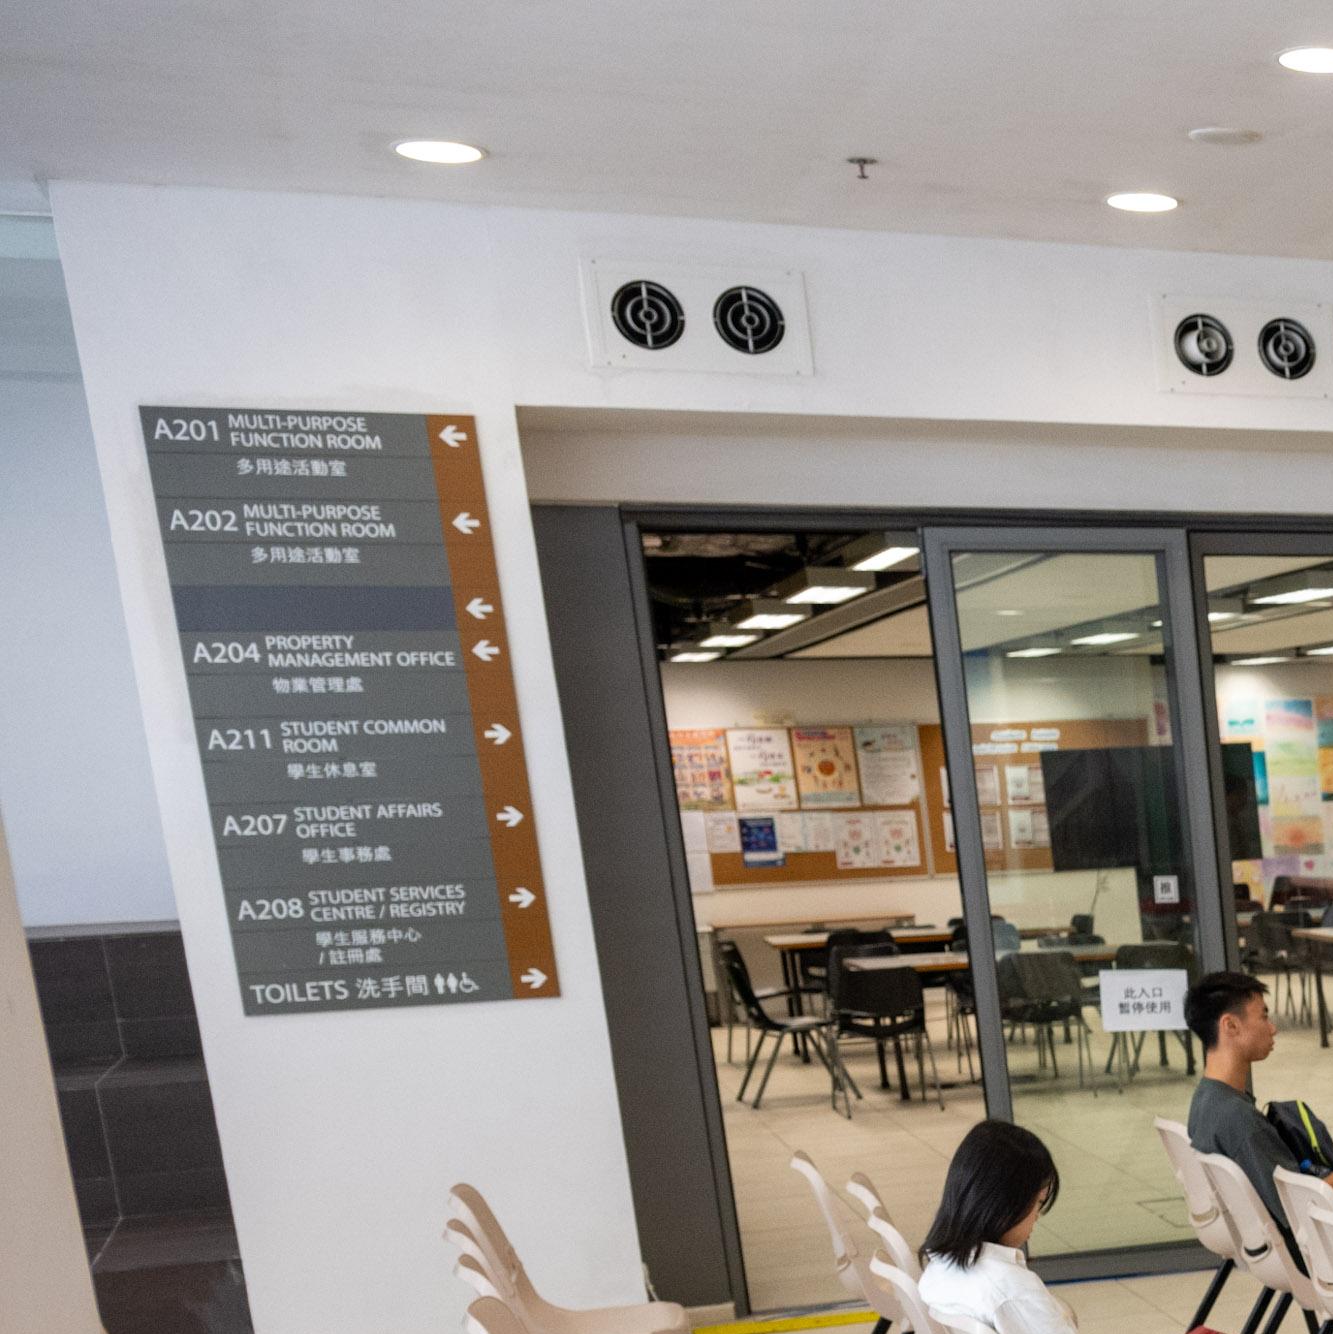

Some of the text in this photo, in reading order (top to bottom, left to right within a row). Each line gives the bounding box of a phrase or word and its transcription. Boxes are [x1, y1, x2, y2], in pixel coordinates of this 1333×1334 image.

[154, 418, 219, 442] A201
[228, 414, 367, 434] MULTI-PURPOSE
[231, 433, 382, 451] FUNCTION ROOM
[236, 458, 347, 477] 多用途活動室
[170, 510, 239, 532] A202
[243, 504, 381, 522] MULTI-PURPOSE
[245, 520, 396, 538] FUNCTION ROOM
[251, 547, 361, 564] 多用途活動室
[265, 635, 354, 650] PROPERTY
[193, 642, 261, 664] A204
[268, 651, 455, 668] MANAGEMENT OFFICE
[272, 677, 364, 694] 物業管理處
[280, 719, 446, 736] STUDENT COMMON
[208, 729, 273, 750] A211
[283, 738, 338, 754] ROOM
[287, 762, 377, 779] 學生休息室
[293, 802, 443, 821] STUDENT AFFAIRS
[222, 814, 288, 836] A207
[296, 822, 356, 838] OFFICE
[302, 845, 392, 864] 學生事務處
[308, 885, 466, 906] STUDENT SERVICES
[238, 898, 304, 921] A208
[310, 901, 466, 922] CENTRE / REGISTRY
[315, 928, 422, 947] 學生服務中心
[250, 975, 430, 1005] TOILETS 洗手間
[1124, 987, 1164, 999] 此入口
[1118, 1002, 1172, 1015] 暫停使用
